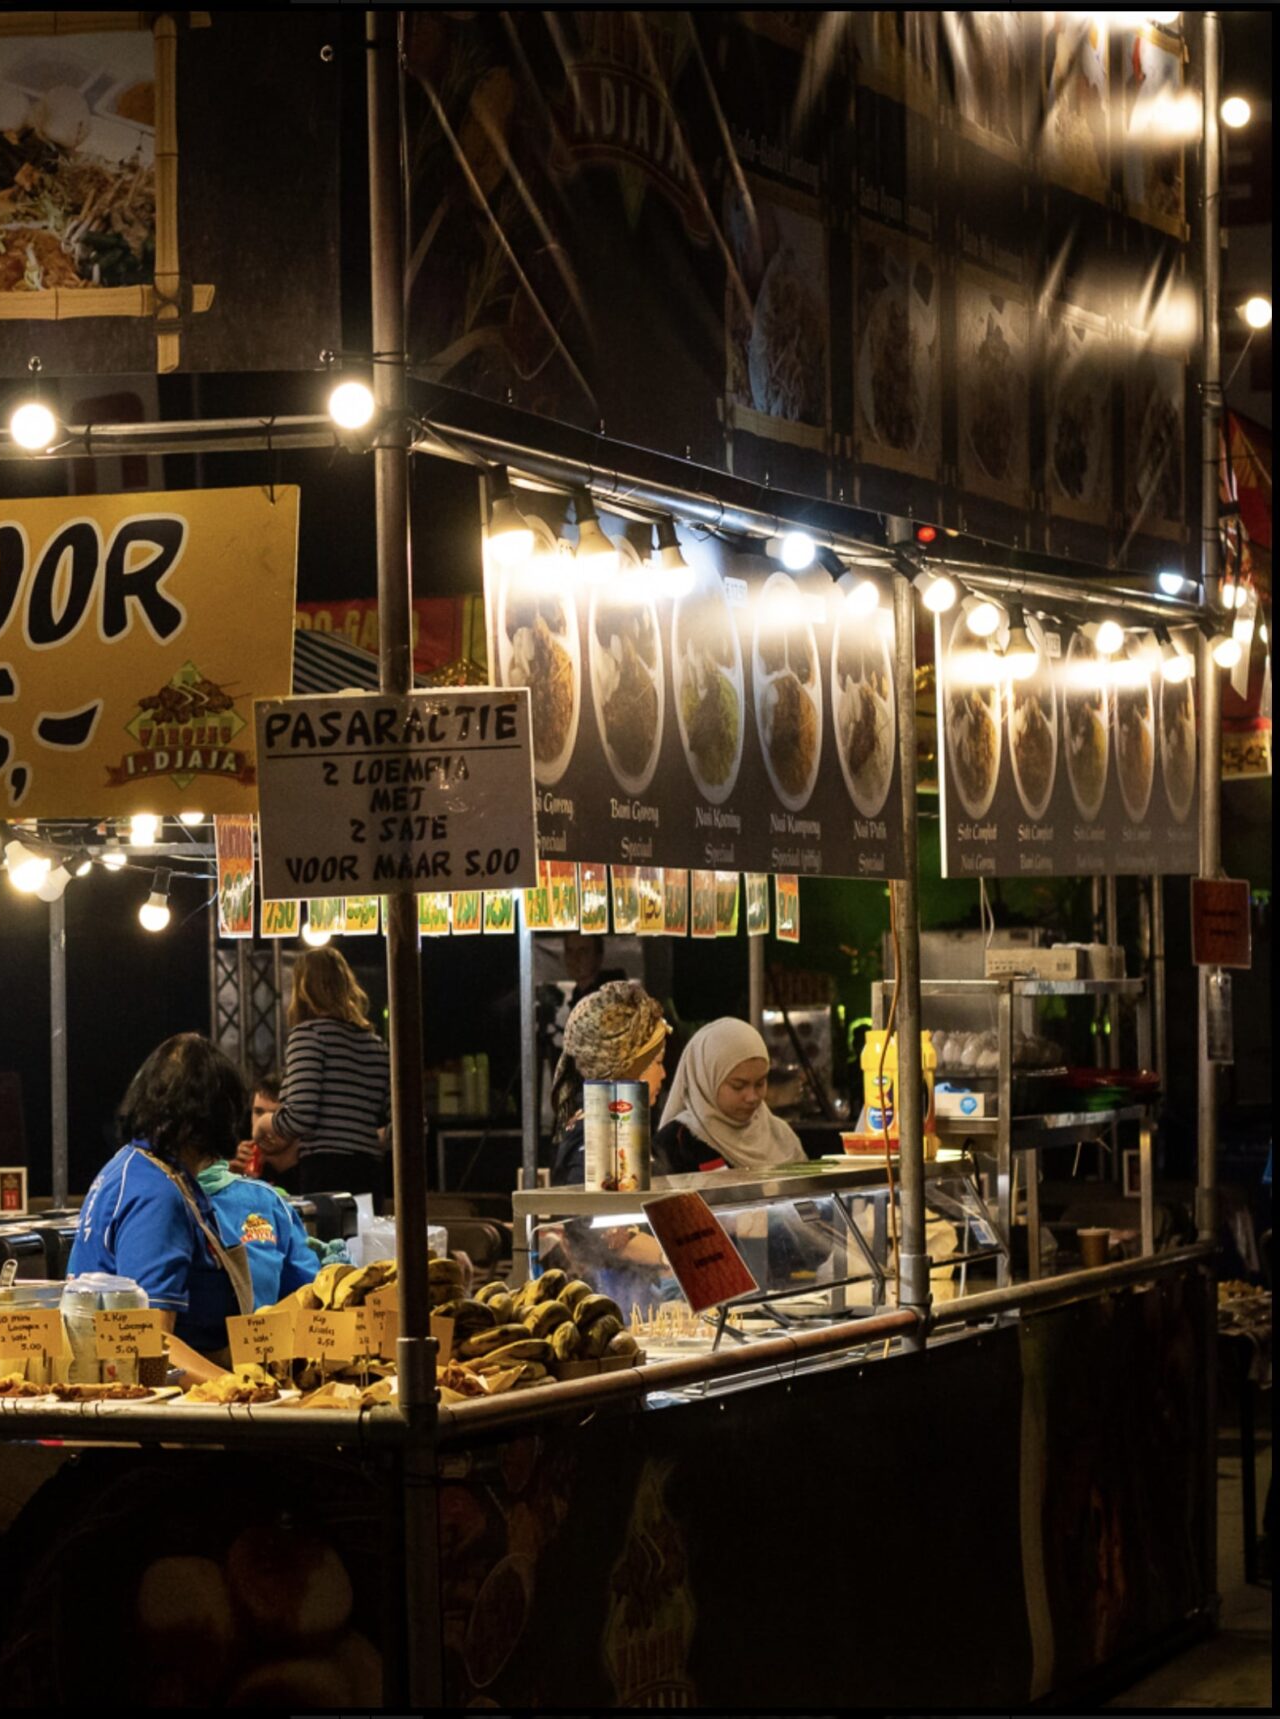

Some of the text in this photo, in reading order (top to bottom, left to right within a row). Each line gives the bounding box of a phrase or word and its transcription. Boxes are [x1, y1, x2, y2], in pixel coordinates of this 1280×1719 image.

[265, 703, 519, 749] PASARACTIE
[322, 756, 471, 786] 2 LOEMPIA
[369, 786, 426, 814] MET
[350, 815, 448, 843] 2 SATE
[285, 853, 360, 883] VOOR
[372, 851, 454, 881] MAAR
[112, 1312, 128, 1323] Kip
